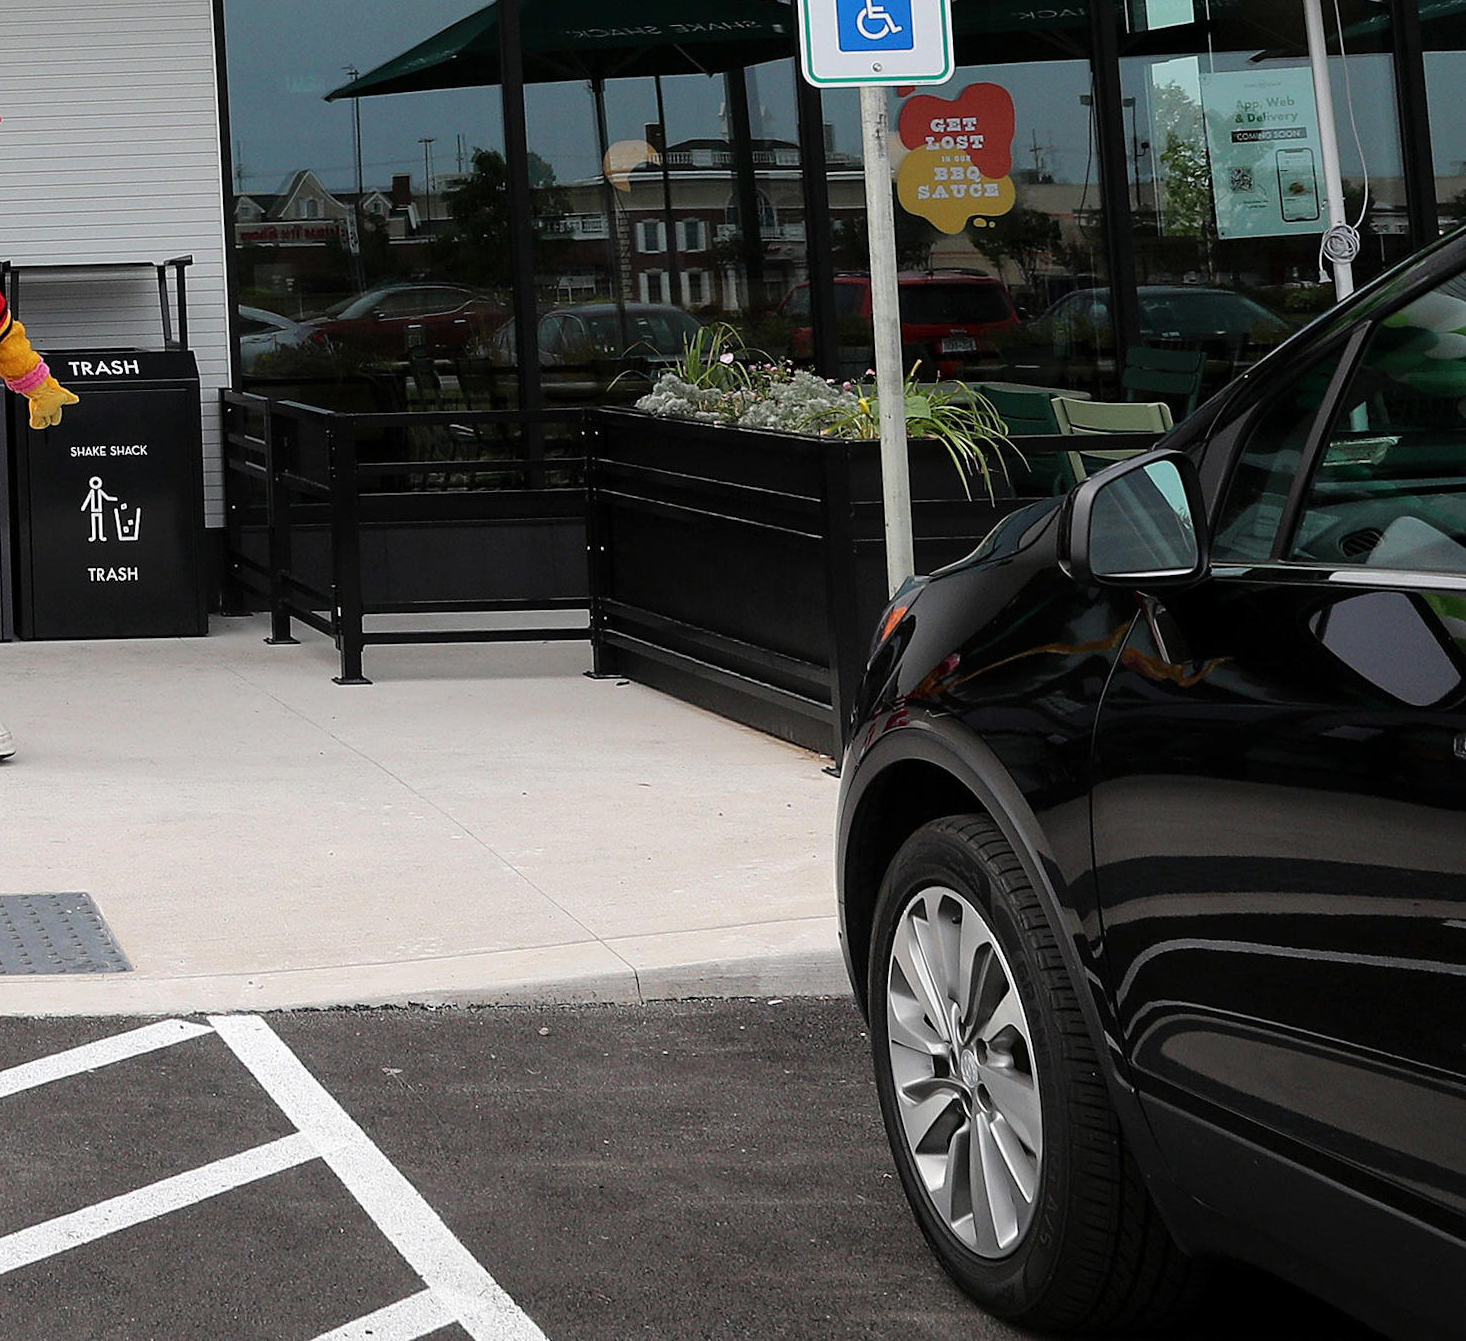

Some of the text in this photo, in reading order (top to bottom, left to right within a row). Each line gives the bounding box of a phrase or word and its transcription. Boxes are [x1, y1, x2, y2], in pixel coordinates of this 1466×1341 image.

[1266, 95, 1295, 107] Web
[930, 117, 977, 132] GET
[1235, 112, 1298, 123] & Delivery
[925, 135, 984, 150] LOST
[1237, 130, 1300, 141] COMING SOON
[934, 166, 981, 182] BBQ
[918, 183, 999, 199] SAUCE
[68, 359, 140, 376] TRASH
[70, 444, 148, 457] SHAKE SHACK
[88, 567, 139, 582] TRASH
